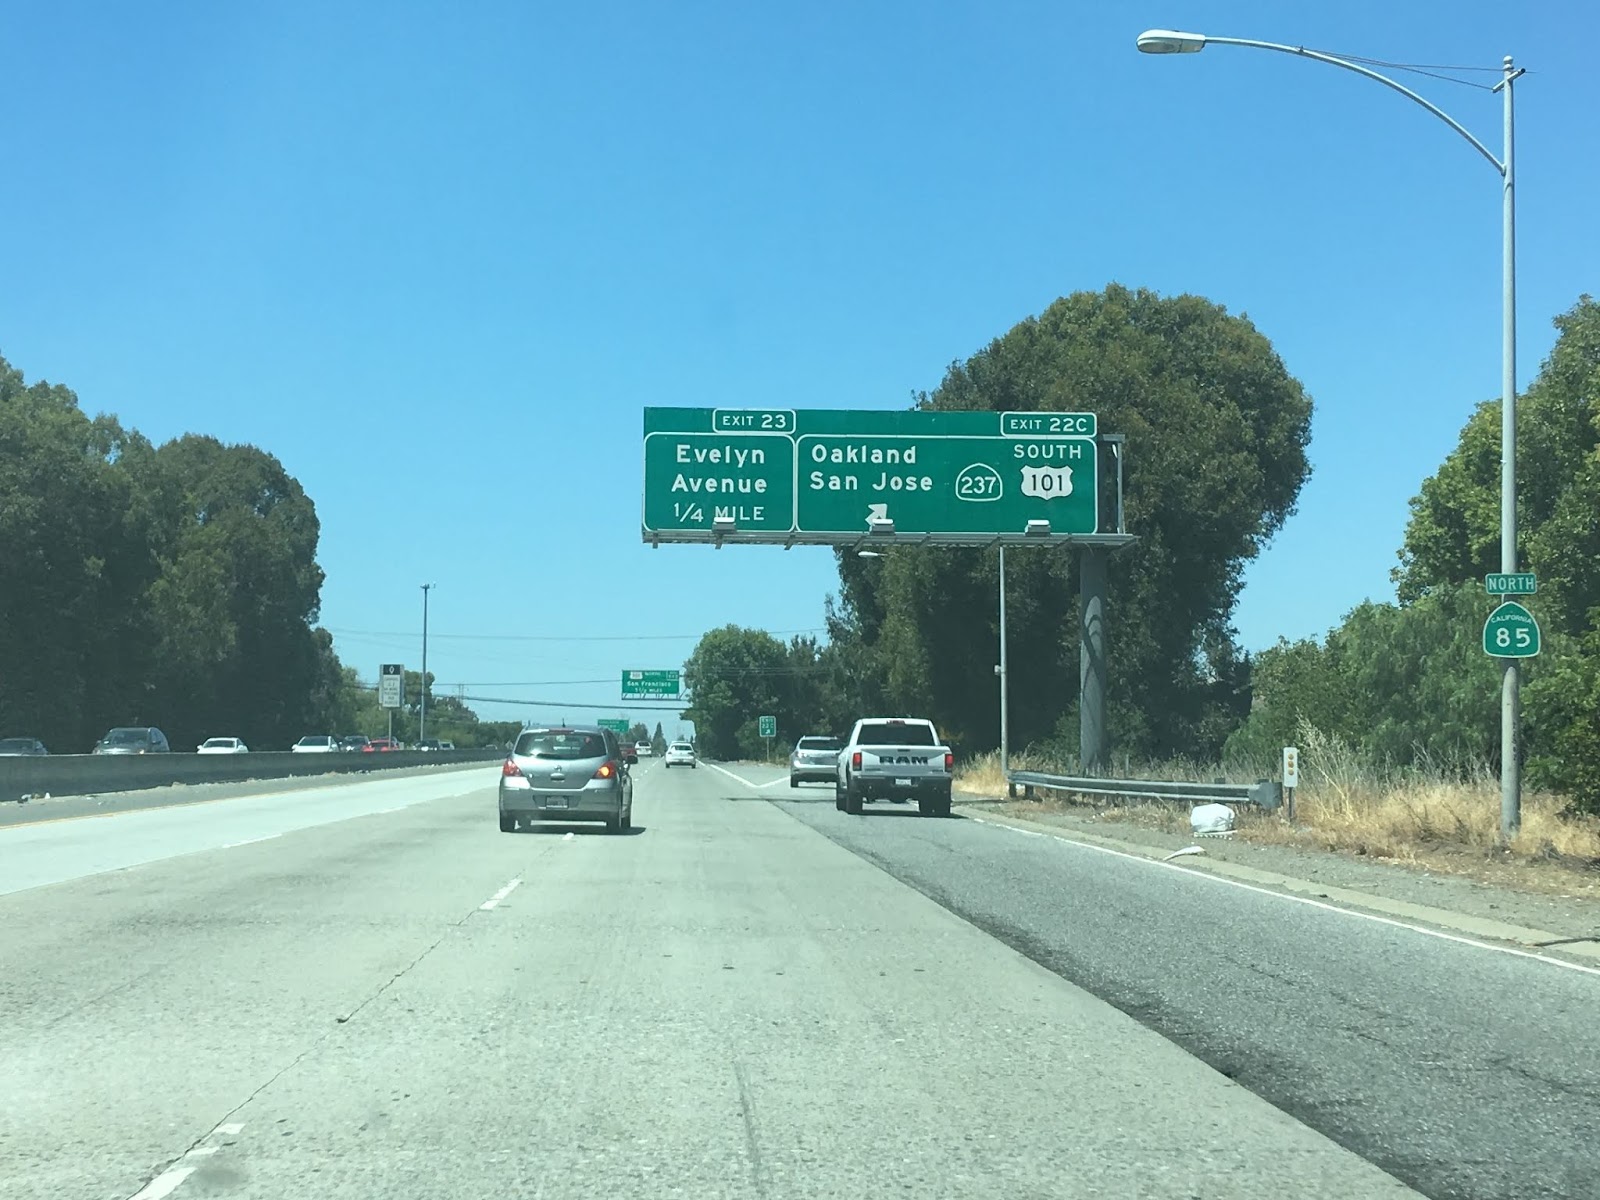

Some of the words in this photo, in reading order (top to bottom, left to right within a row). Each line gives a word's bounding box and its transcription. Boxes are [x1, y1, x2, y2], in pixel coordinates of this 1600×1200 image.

[722, 416, 754, 426] EXIT
[761, 414, 786, 428] 23
[1010, 419, 1042, 430] EXIT
[1050, 417, 1087, 432] 22C
[676, 444, 765, 468] Evelyn
[811, 444, 916, 464] Oakland
[1013, 444, 1082, 459] SOUTH
[671, 474, 768, 493] Avenue
[810, 471, 858, 490] San
[872, 472, 933, 491] Jose
[961, 476, 997, 494] 237
[1031, 474, 1063, 492] 101
[673, 502, 704, 522] 1/4
[714, 505, 764, 521] MILE
[1488, 577, 1534, 591] NORTH
[1490, 614, 1532, 624] CALIFORNIA
[1496, 627, 1531, 648] 85
[879, 756, 929, 765] RAM
